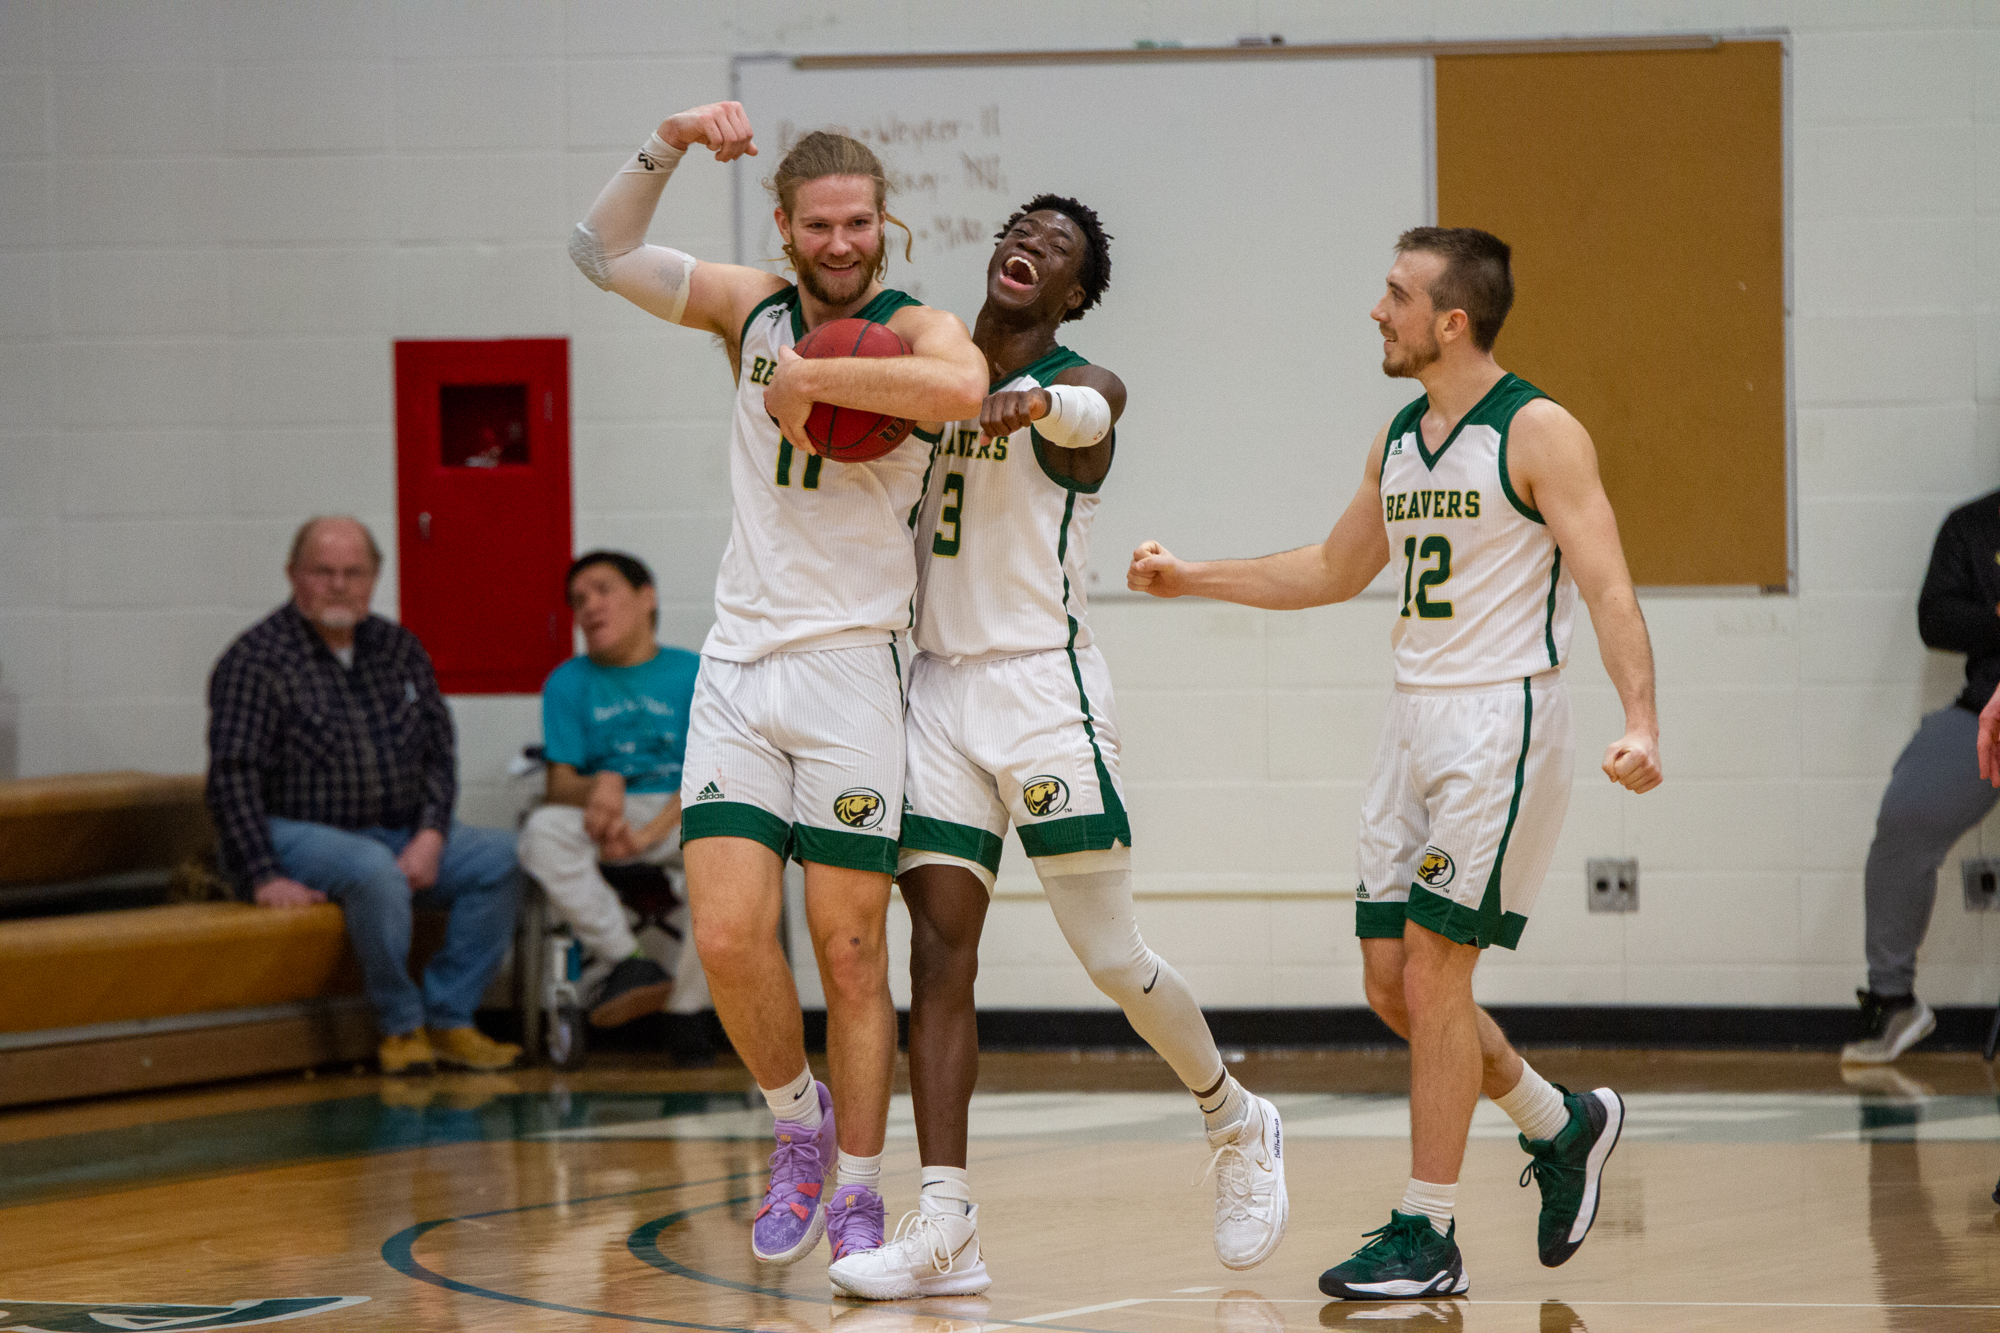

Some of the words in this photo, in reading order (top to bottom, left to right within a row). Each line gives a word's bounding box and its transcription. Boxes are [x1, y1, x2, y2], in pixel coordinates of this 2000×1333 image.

[931, 471, 964, 559] 3
[1386, 490, 1480, 522] BEAVERS
[1400, 533, 1455, 621] 12
[696, 792, 725, 801] adidas
